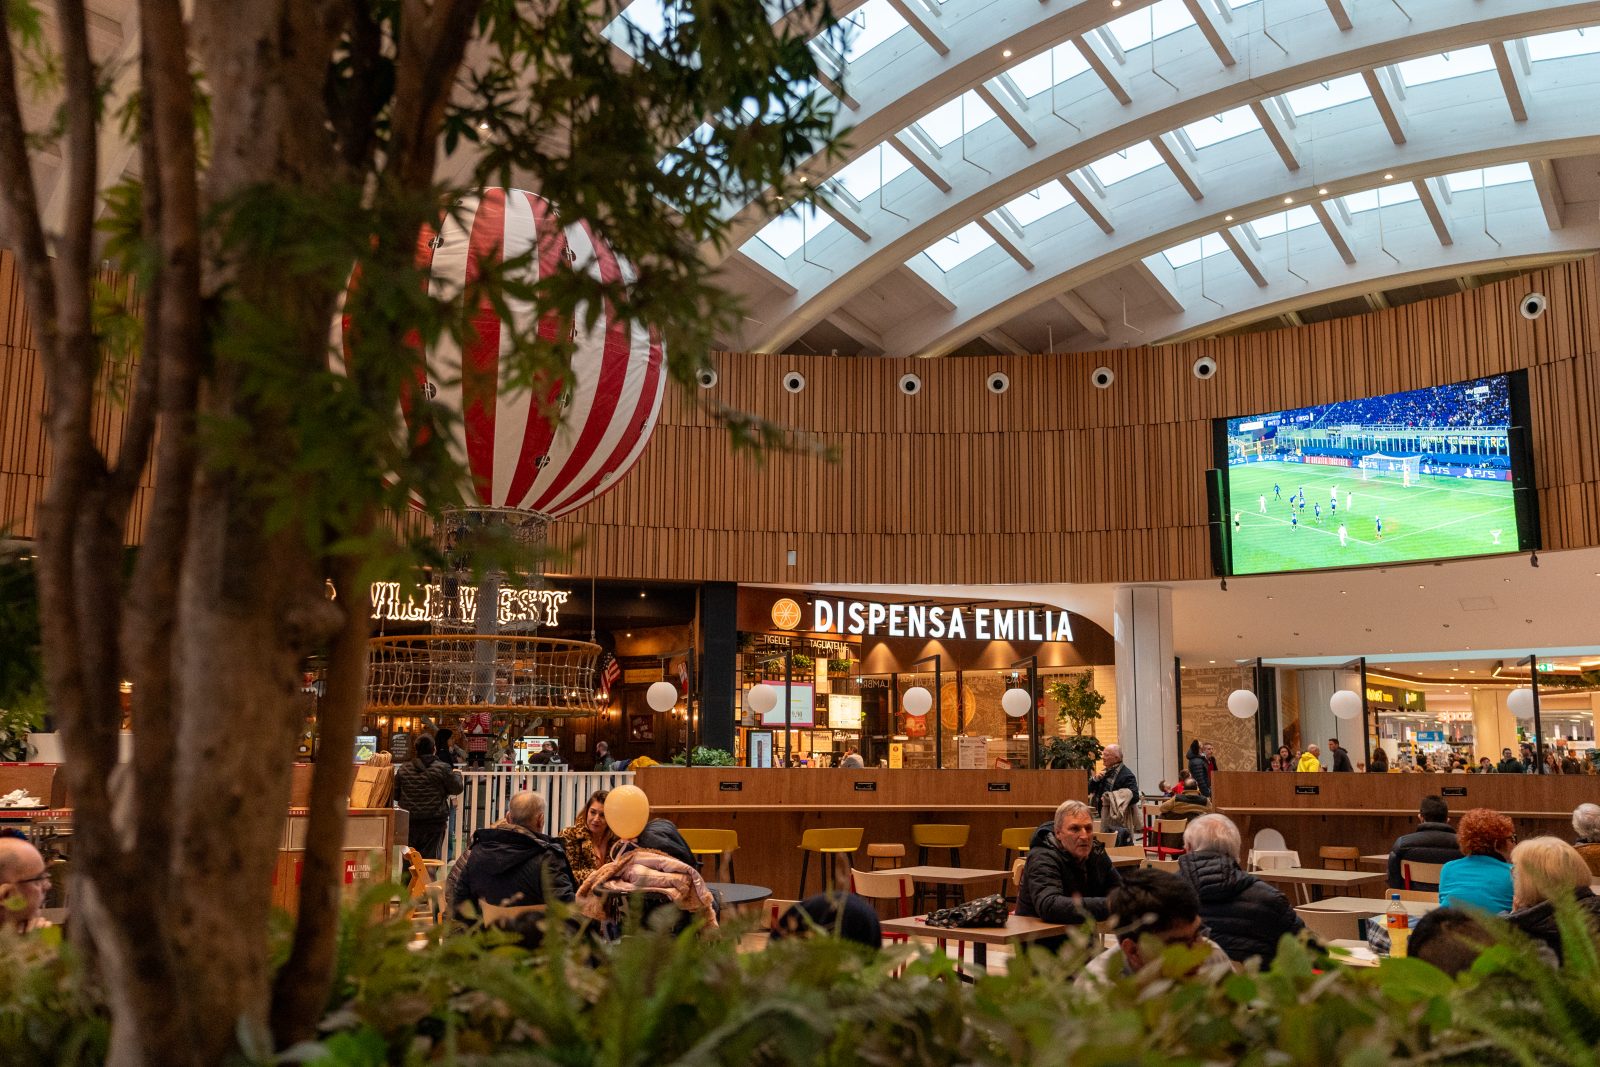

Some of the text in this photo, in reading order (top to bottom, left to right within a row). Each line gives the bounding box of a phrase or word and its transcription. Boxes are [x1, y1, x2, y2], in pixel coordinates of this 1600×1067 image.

[1474, 470, 1496, 478] PS5
[814, 599, 1074, 642] DISPENSA EMILIA
[764, 635, 790, 646] TIGELLE
